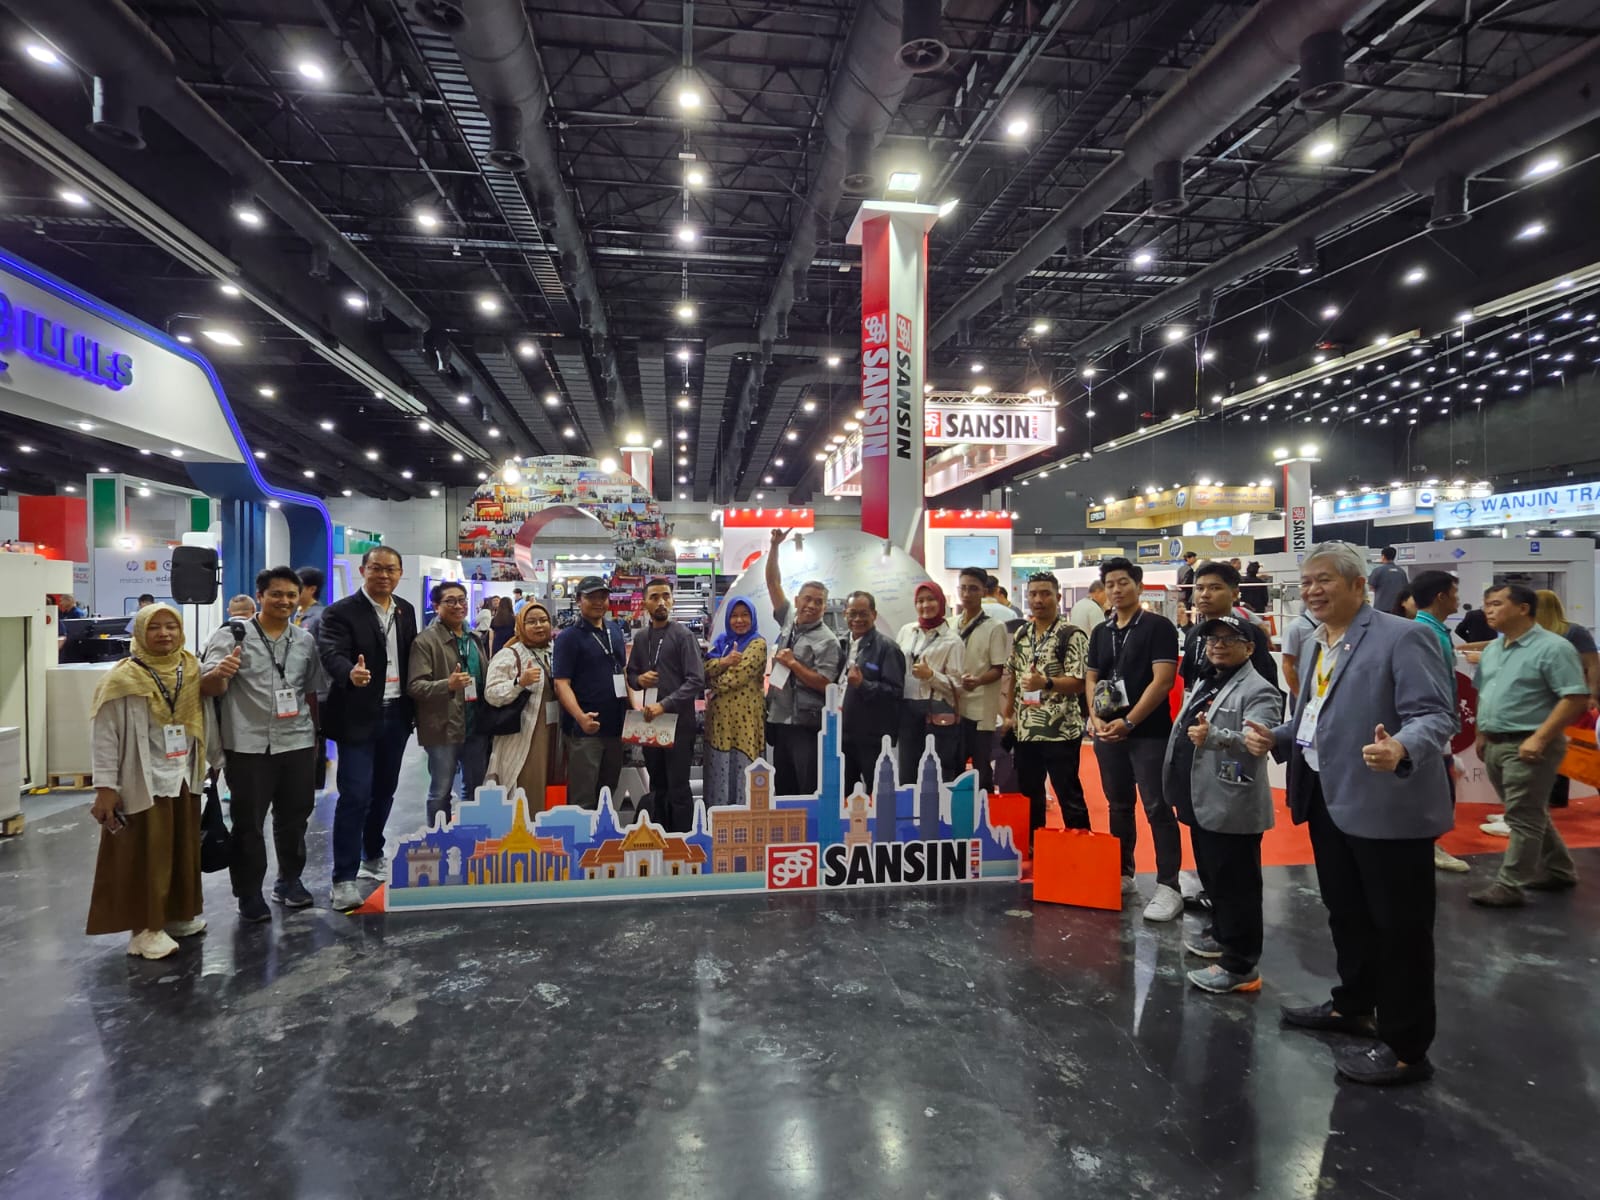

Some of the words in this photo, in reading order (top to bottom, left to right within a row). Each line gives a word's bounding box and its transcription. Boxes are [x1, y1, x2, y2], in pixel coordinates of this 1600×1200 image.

[863, 347, 889, 458] SANSIN
[896, 351, 911, 460] SANSIN
[946, 413, 1030, 439] SANSIN
[1481, 490, 1558, 512] WANJIN
[1293, 520, 1306, 553] SANSI
[824, 841, 967, 887] SANSIN
